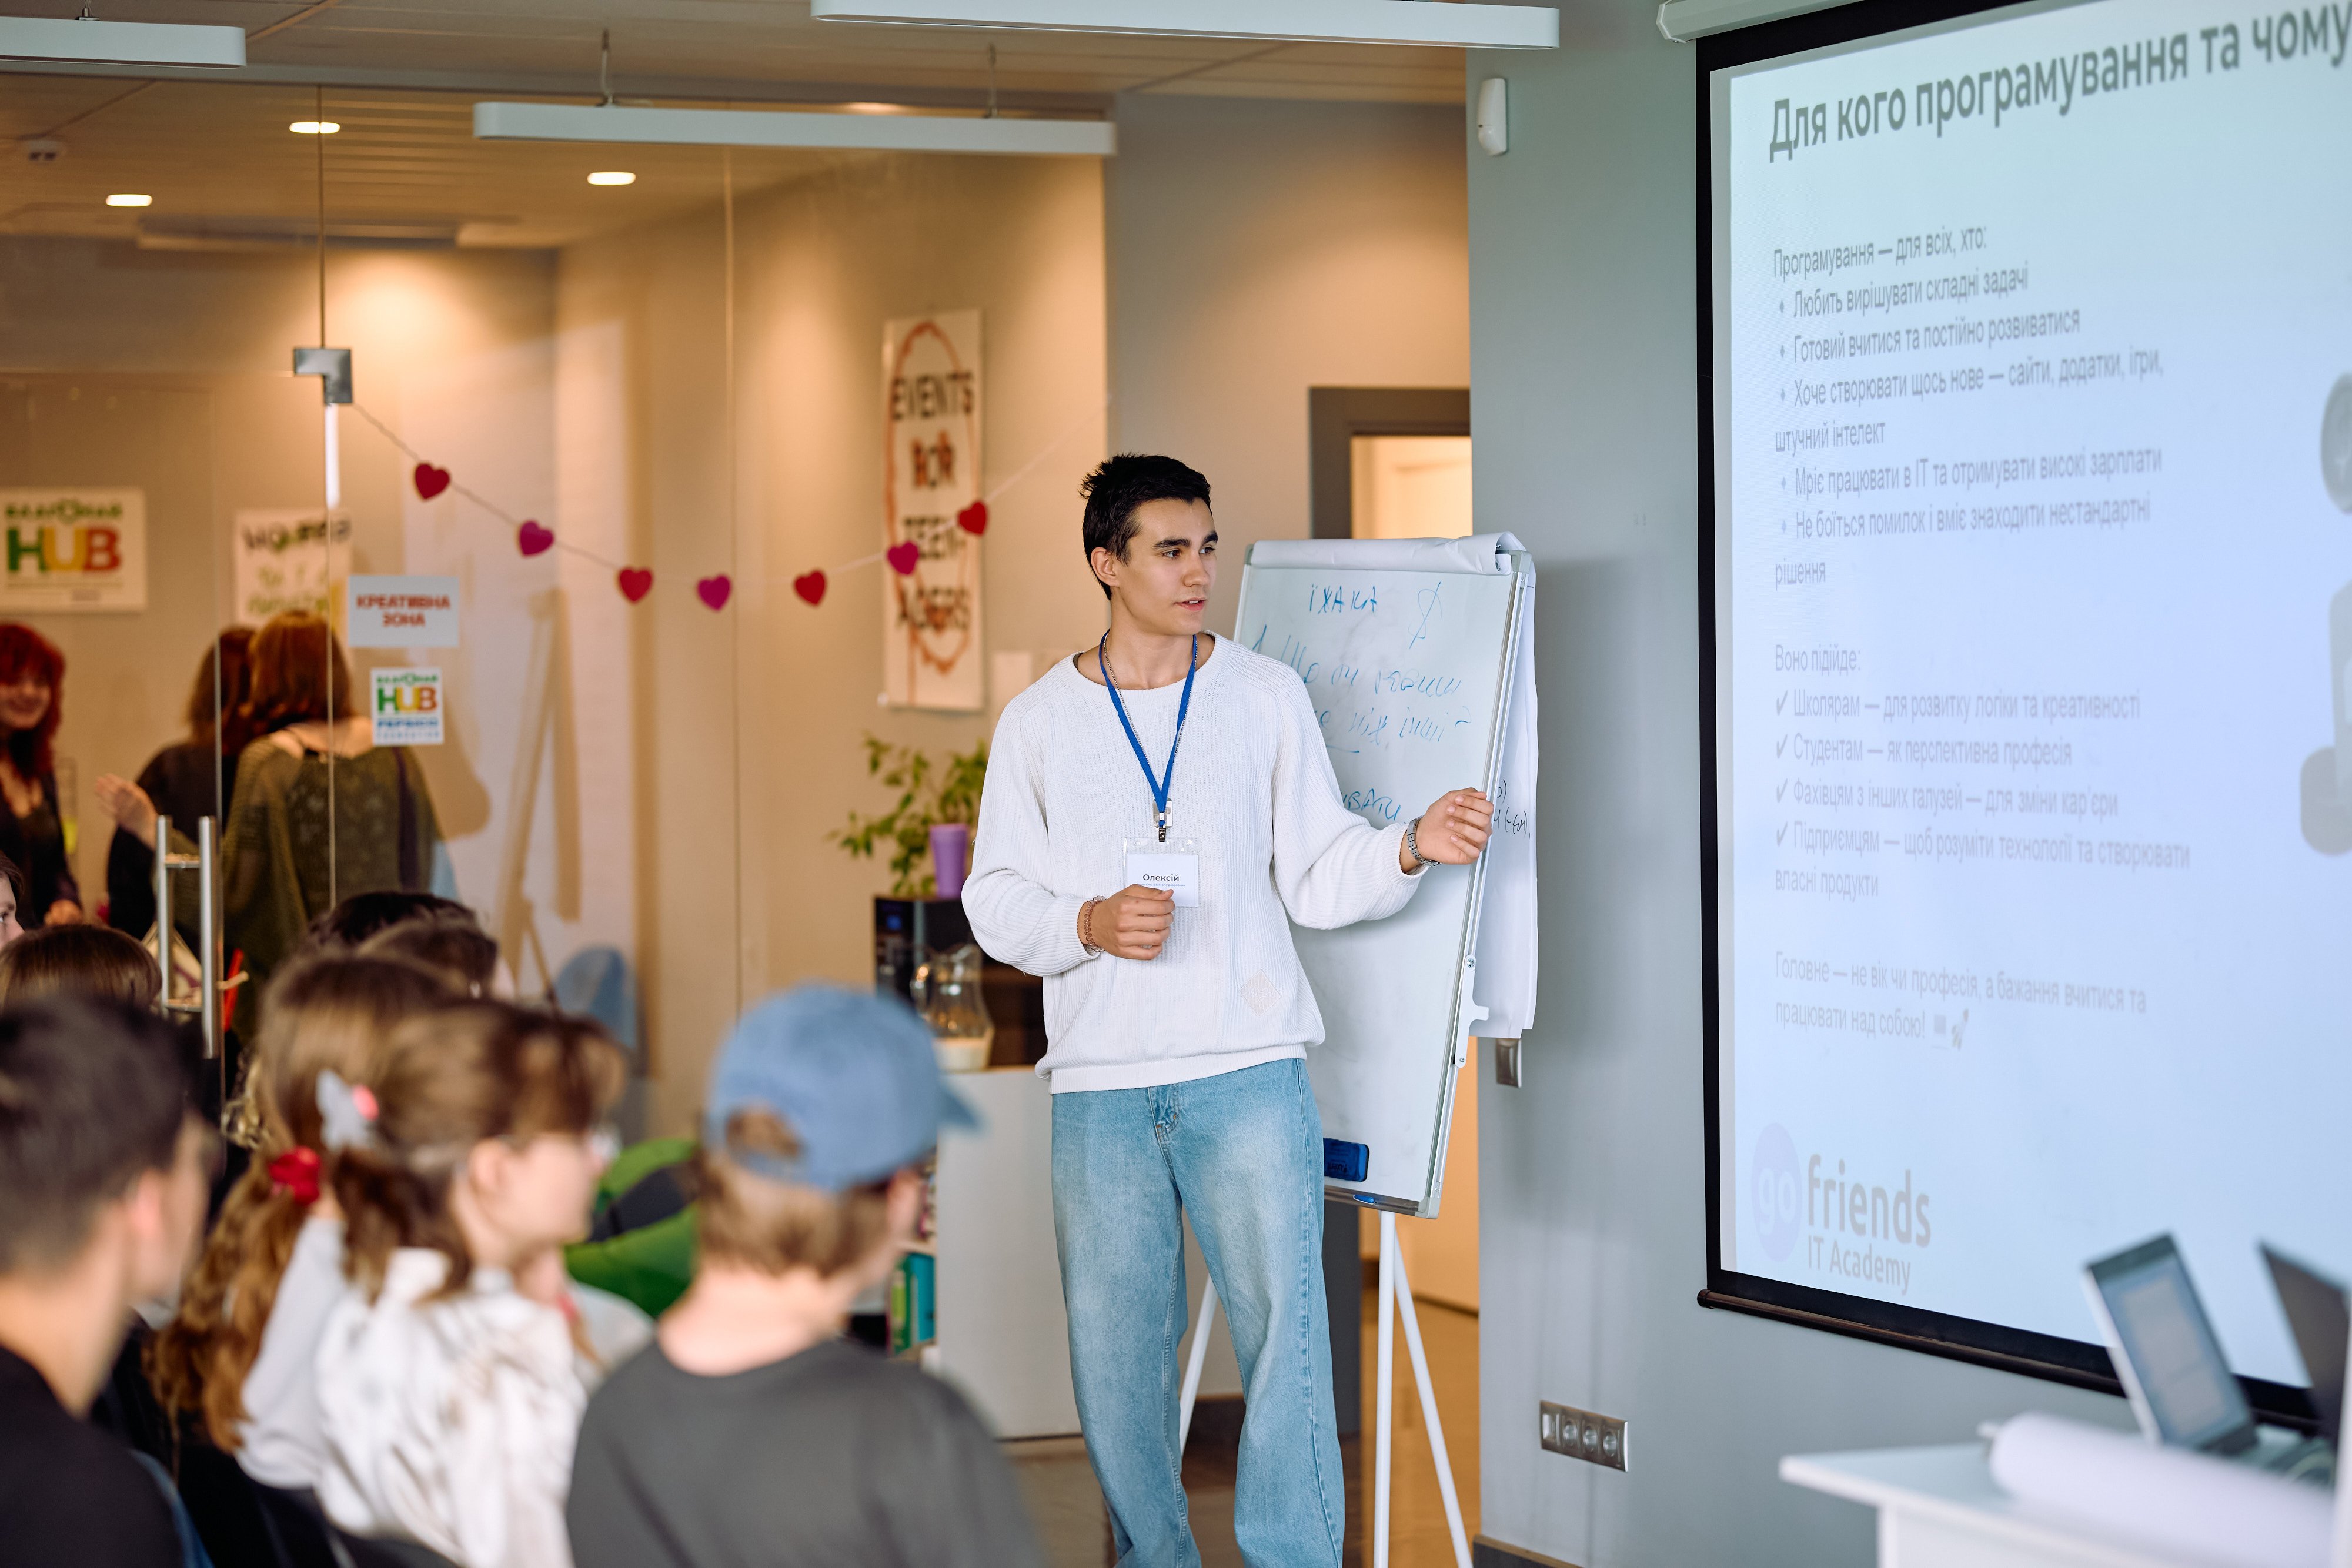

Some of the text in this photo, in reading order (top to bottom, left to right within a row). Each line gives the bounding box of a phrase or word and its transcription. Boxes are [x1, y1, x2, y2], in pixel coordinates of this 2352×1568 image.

[1770, 2, 2352, 163] Для кого програмування та чому
[1774, 243, 1873, 282] Програмування
[1896, 236, 1921, 265] для
[1926, 225, 1956, 258] всіх,
[1960, 226, 1987, 251] хто:
[1794, 260, 2027, 317] Любить вирішувати складні задачі
[1795, 309, 2080, 363] Готовий вчитися та постійно розвиватися
[1795, 379, 1826, 407] Хоче
[1831, 375, 1907, 407] створювати
[1912, 372, 1946, 402] щось
[1951, 367, 1983, 392] нове
[2009, 356, 2054, 386] сайти,
[2059, 353, 2125, 386] додатки,
[1776, 420, 1885, 458] штучний інтелект
[1796, 467, 1824, 501] Мріє
[1829, 467, 1899, 499] працювати
[1905, 467, 1911, 488] в
[1933, 463, 1947, 486] та
[1952, 457, 2035, 490] отримувати
[2040, 446, 2085, 479] високі
[2091, 449, 2162, 481] зарплати
[1796, 511, 1812, 539] Не
[1816, 510, 1865, 537] боїться
[1870, 511, 1926, 536] помилок
[1937, 503, 1966, 531] вміє
[1971, 504, 2044, 533] знаходити
[2050, 491, 2150, 529] нестандартні
[6, 526, 122, 573] HUB
[1776, 558, 1825, 591] рішення
[357, 594, 451, 610] КРЕАТИВНА
[383, 612, 425, 628] ЗОНА
[1776, 644, 1860, 676] Воно підійде:
[377, 686, 437, 713] HUB
[1794, 688, 1860, 723] Школярам
[1884, 695, 1907, 723] для
[1912, 694, 1970, 724] розвитку
[1975, 688, 2017, 718] логіки
[2022, 696, 2038, 718] та
[2043, 688, 2140, 725] креативності
[1794, 733, 1862, 767] Студентам
[1887, 740, 1902, 763] як
[1906, 740, 1999, 769] перспективна
[2004, 735, 2072, 771] професія
[1794, 777, 1853, 813] Фахівцям
[1857, 785, 1863, 807] з
[1869, 780, 1908, 808] інших
[1912, 781, 1962, 817] галузей
[1986, 790, 2013, 817] для
[2018, 785, 2057, 814] зміни
[1794, 821, 1879, 858] Підприємцям
[1905, 827, 1932, 862] щоб
[1937, 829, 1994, 864] розуміти
[1999, 833, 2072, 863] технології
[2077, 839, 2093, 863] та
[2098, 841, 2189, 872] створювати
[1776, 865, 1878, 903] власні продукти
[1776, 951, 1829, 982] Головне
[1852, 963, 1867, 987] не
[1871, 960, 1887, 989] вік
[1891, 967, 1907, 990] чи
[1912, 967, 1982, 1004] професія,
[1986, 977, 1994, 998] а
[1997, 971, 2059, 1006] бажання
[2064, 984, 2124, 1012] вчитися
[2130, 989, 2146, 1014] та
[1776, 1002, 1925, 1039] працювати над собою!
[1759, 1168, 1796, 1235] go
[1808, 1154, 1931, 1248] friends
[1808, 1235, 1911, 1296] IT Academy
